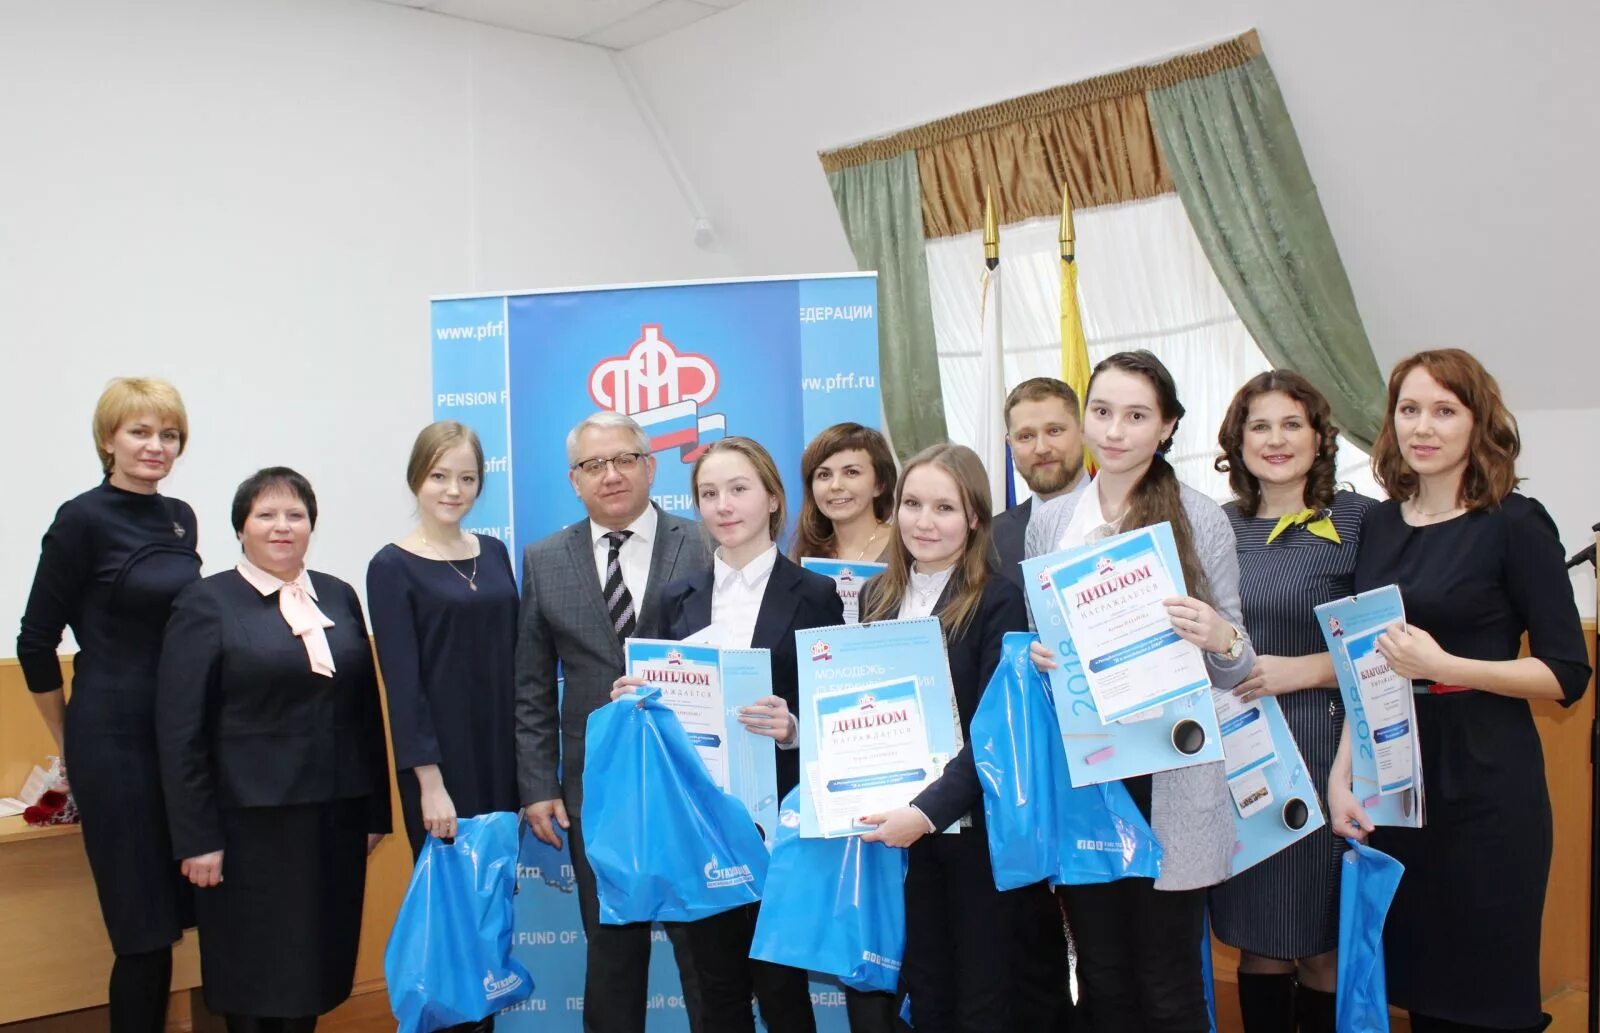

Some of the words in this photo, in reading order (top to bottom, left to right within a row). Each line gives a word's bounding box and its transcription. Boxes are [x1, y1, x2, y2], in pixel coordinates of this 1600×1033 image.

[800, 305, 873, 323] ЕДЕРАЦИИ
[438, 392, 497, 407] PENSION
[1076, 564, 1152, 609] ДИПЛОМ
[642, 669, 710, 687] ДИПЛОМ
[832, 709, 908, 734] ДИПЛОМ
[519, 931, 556, 945] FUND
[560, 930, 577, 944] OF
